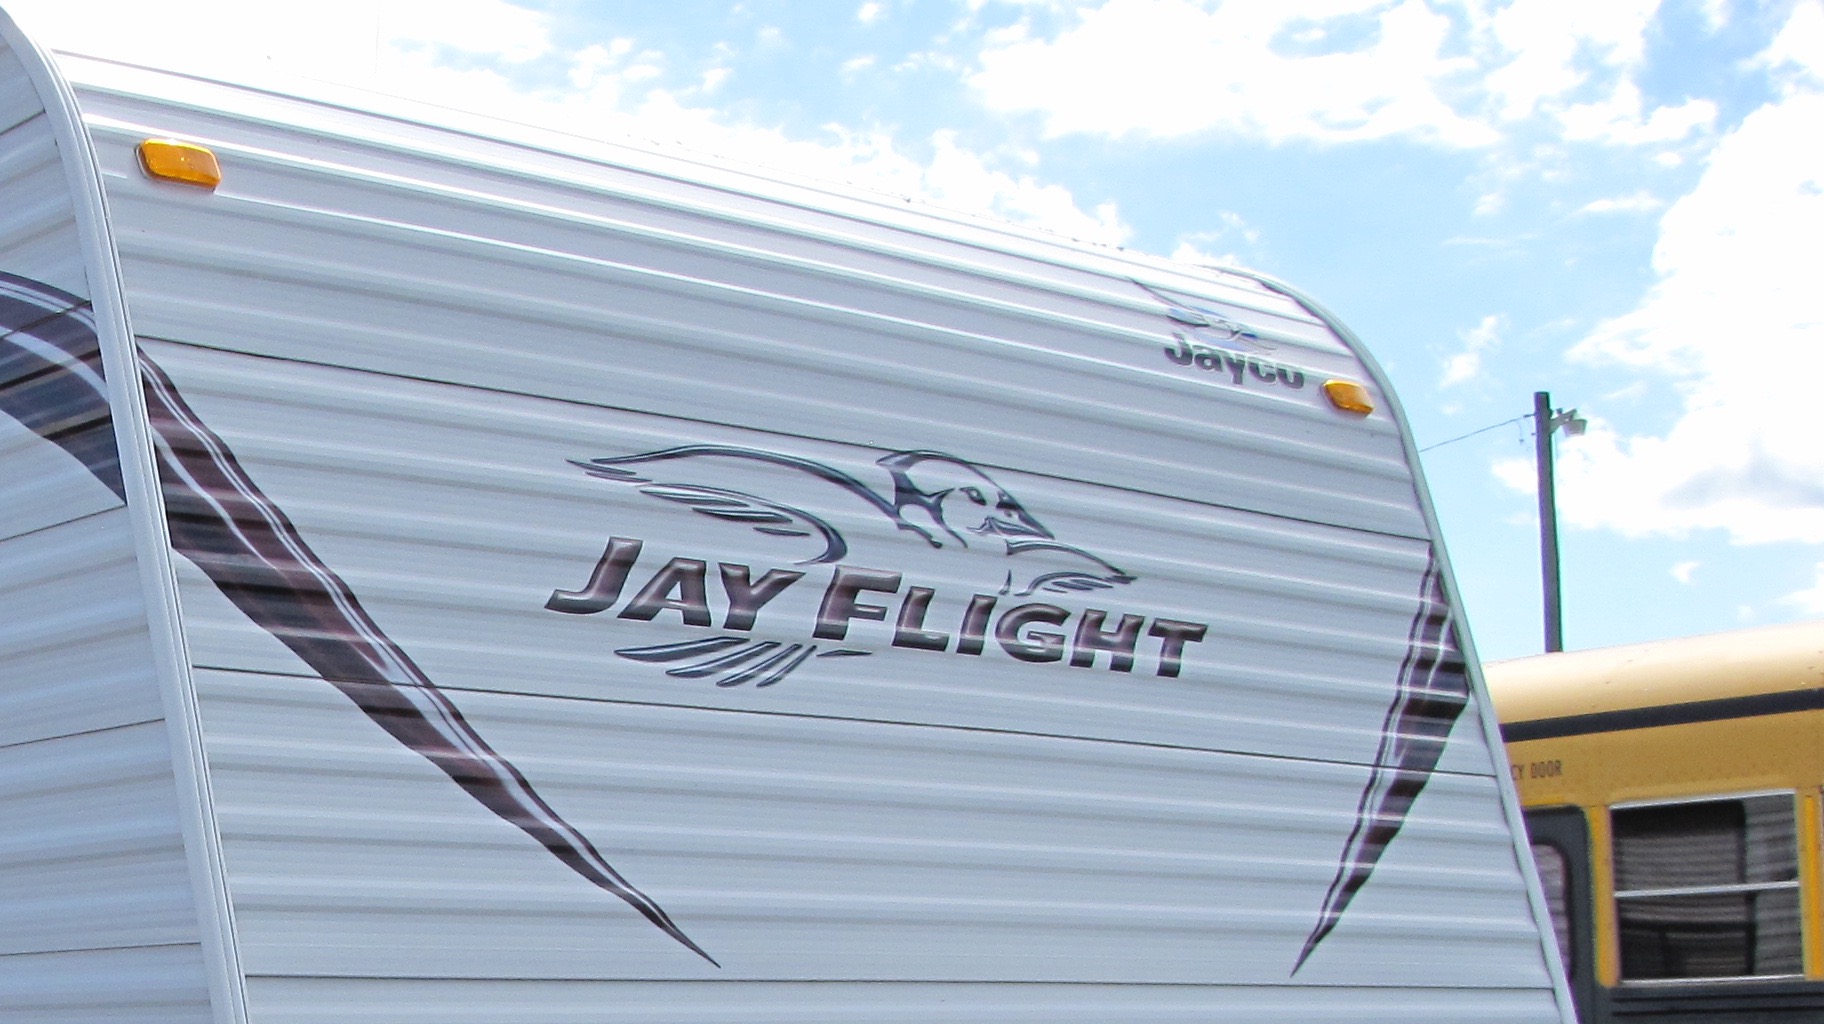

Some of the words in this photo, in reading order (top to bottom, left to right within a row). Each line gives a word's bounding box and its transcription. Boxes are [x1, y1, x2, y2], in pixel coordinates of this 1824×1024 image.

[1164, 331, 1304, 389] Jayco
[544, 537, 805, 631] JAY
[812, 565, 1207, 678] FLIGHT
